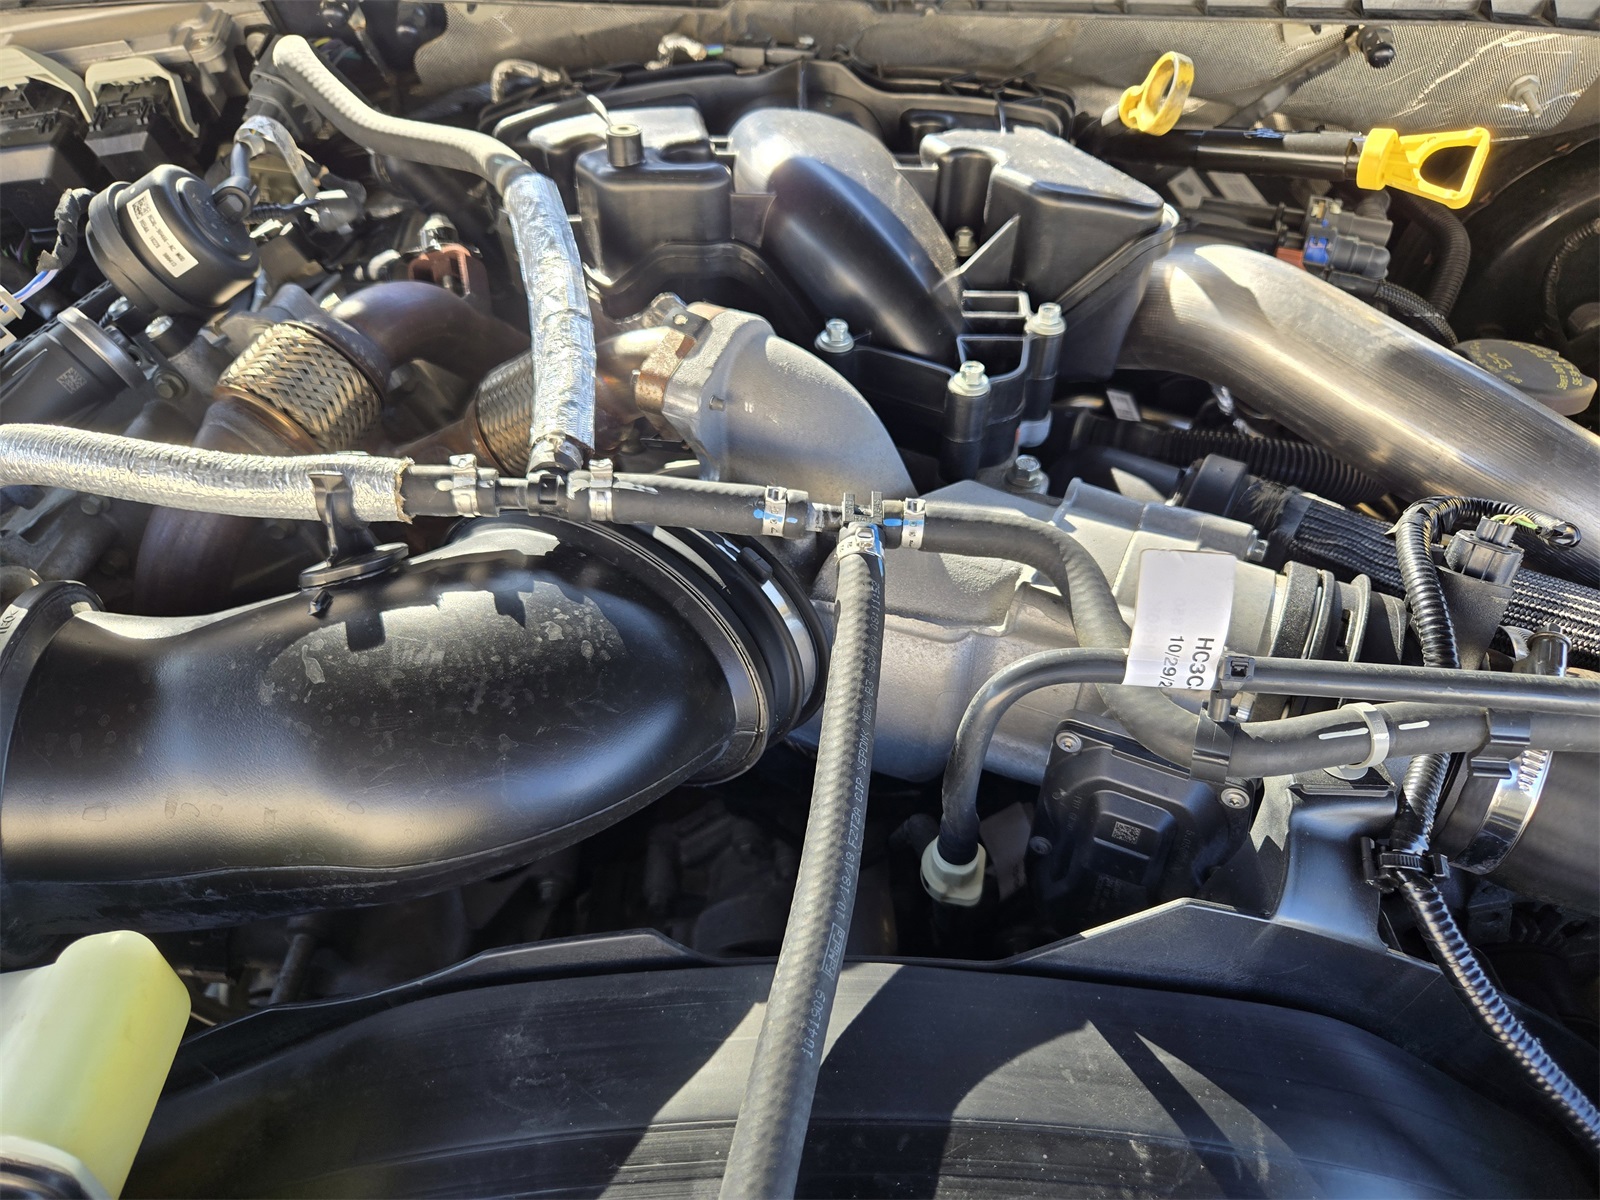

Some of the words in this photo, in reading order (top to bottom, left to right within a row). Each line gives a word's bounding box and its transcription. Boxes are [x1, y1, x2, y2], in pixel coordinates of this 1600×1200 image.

[801, 988, 826, 1058] 1041909
[823, 927, 847, 977] FoMoCo
[854, 776, 864, 803] CIP
